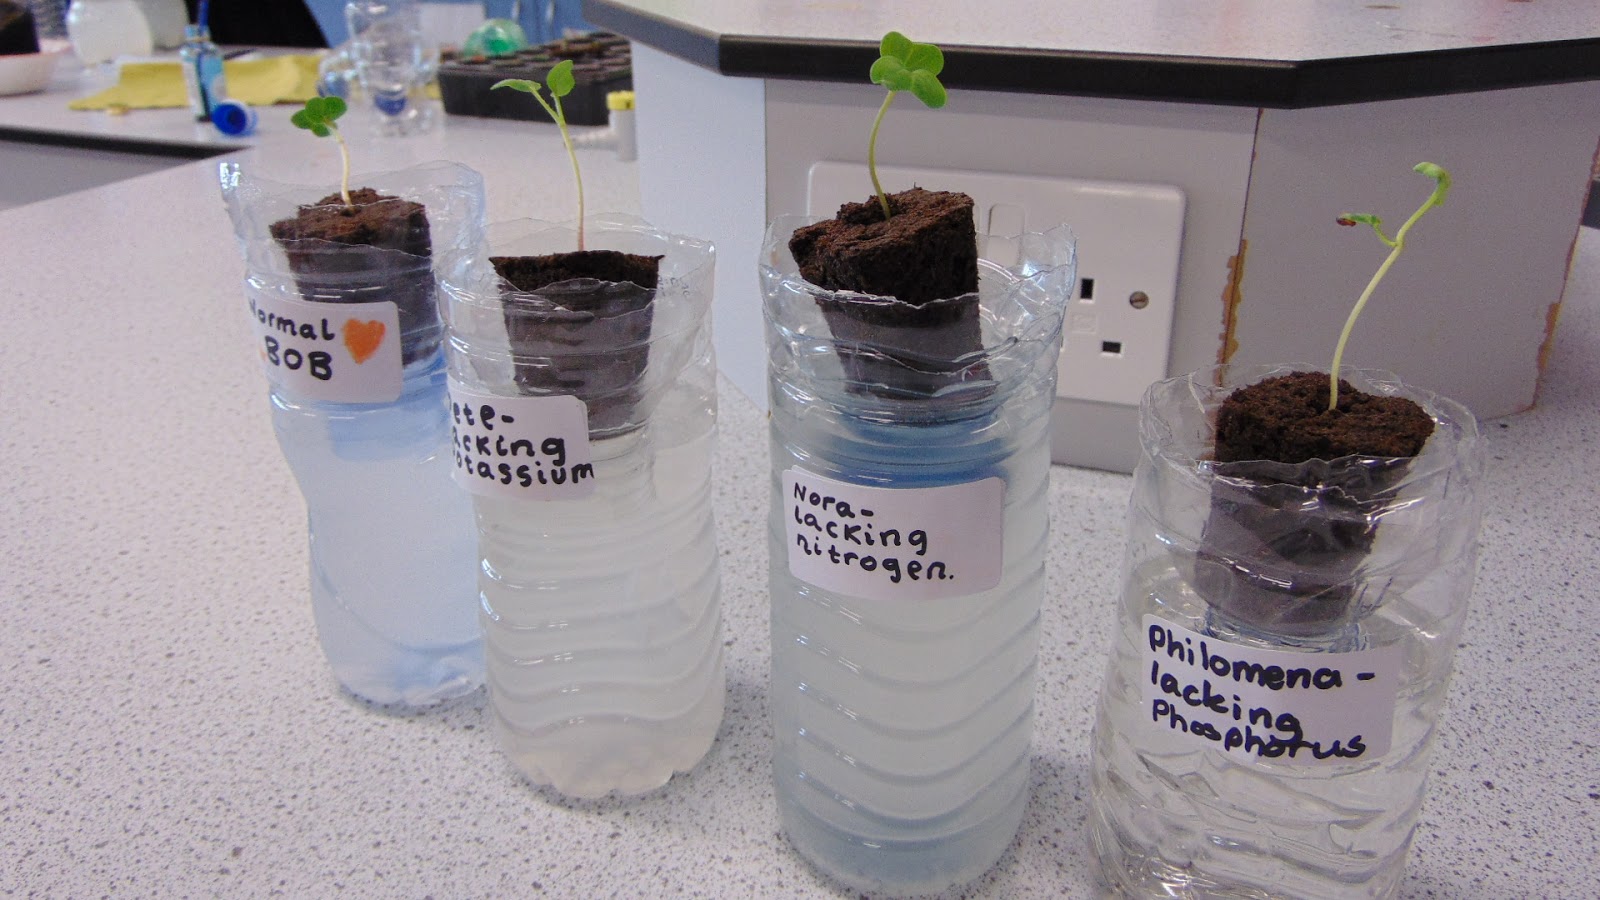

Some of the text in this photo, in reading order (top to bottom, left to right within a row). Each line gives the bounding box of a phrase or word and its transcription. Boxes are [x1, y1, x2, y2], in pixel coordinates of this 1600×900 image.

[265, 335, 332, 381] BOB
[794, 482, 874, 518] Nora-
[794, 505, 927, 555] lacking
[796, 533, 954, 583] nitrogen.
[1151, 660, 1304, 742] lacking
